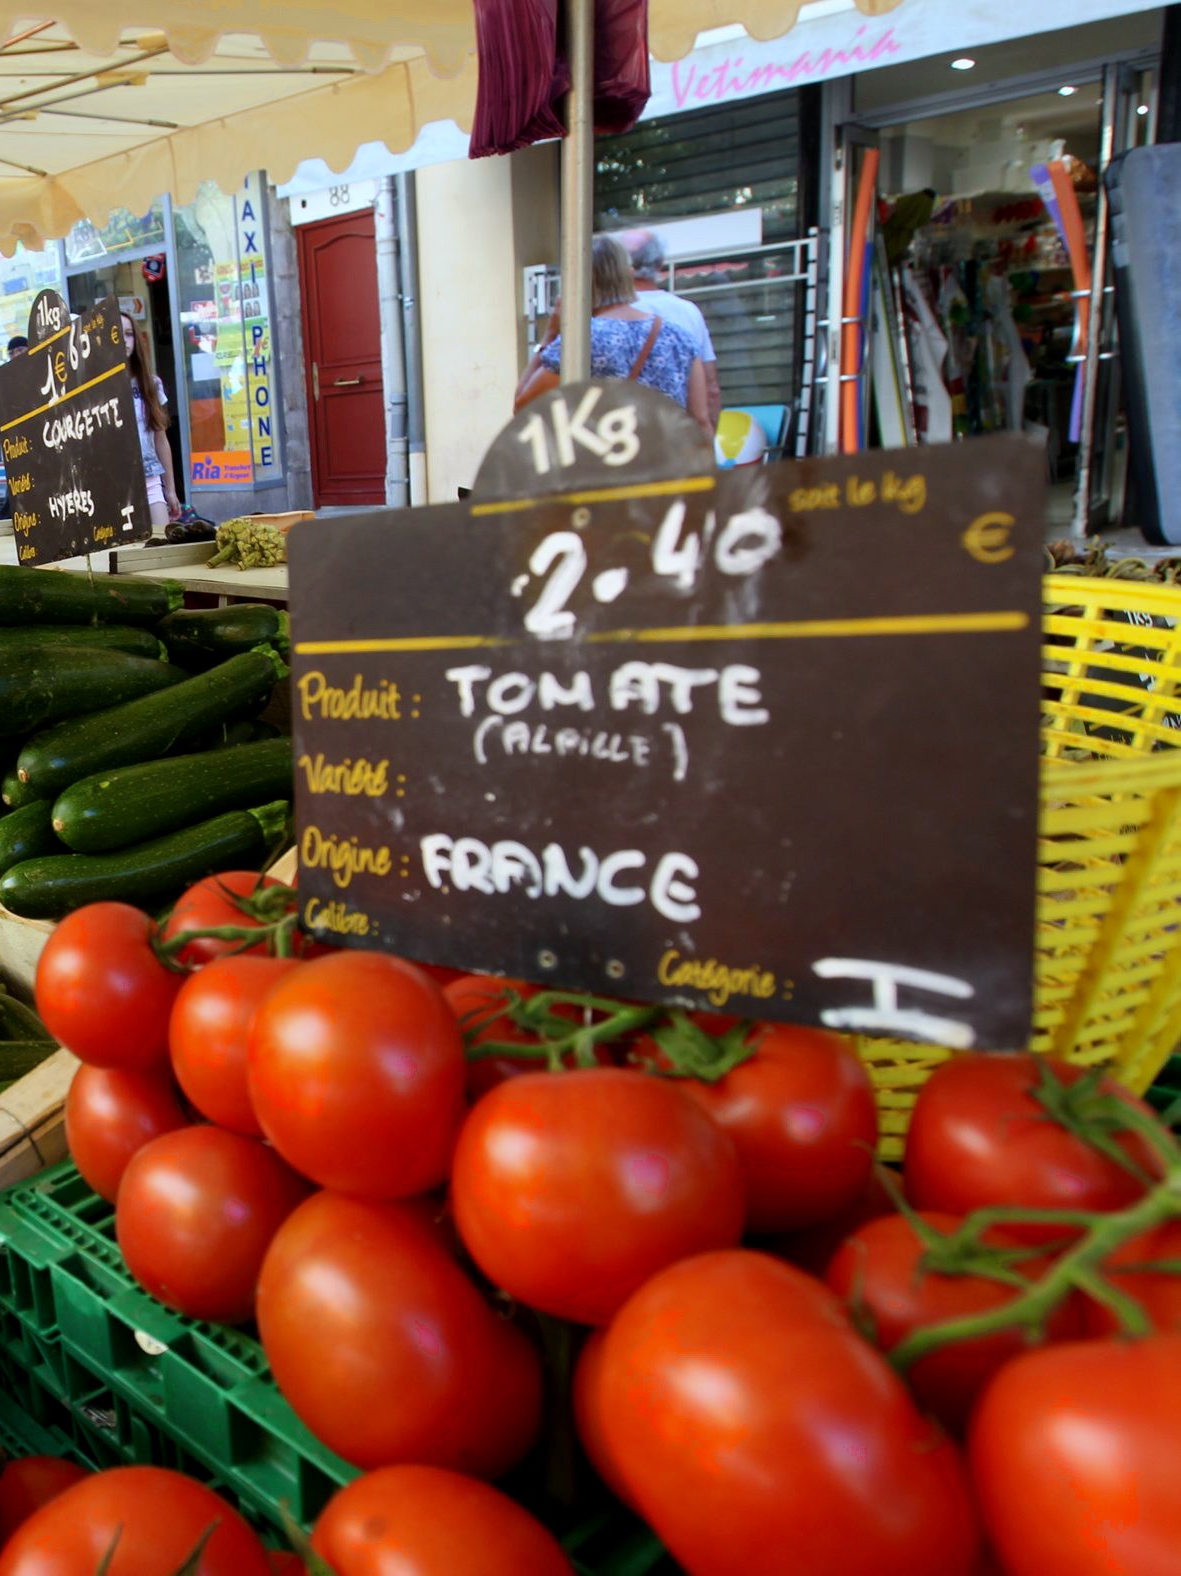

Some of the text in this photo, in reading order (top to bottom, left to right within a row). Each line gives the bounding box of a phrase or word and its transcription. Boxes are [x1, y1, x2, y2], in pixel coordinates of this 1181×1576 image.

[671, 25, 900, 107] Vetimania
[242, 176, 259, 283] AXI
[252, 326, 274, 467] PHONE
[519, 387, 640, 474] 1Kg
[193, 456, 221, 480] Ria
[882, 470, 927, 514] kg
[961, 511, 1016, 564] €
[447, 661, 770, 726] TOMATE
[420, 833, 701, 922] FRANCE
